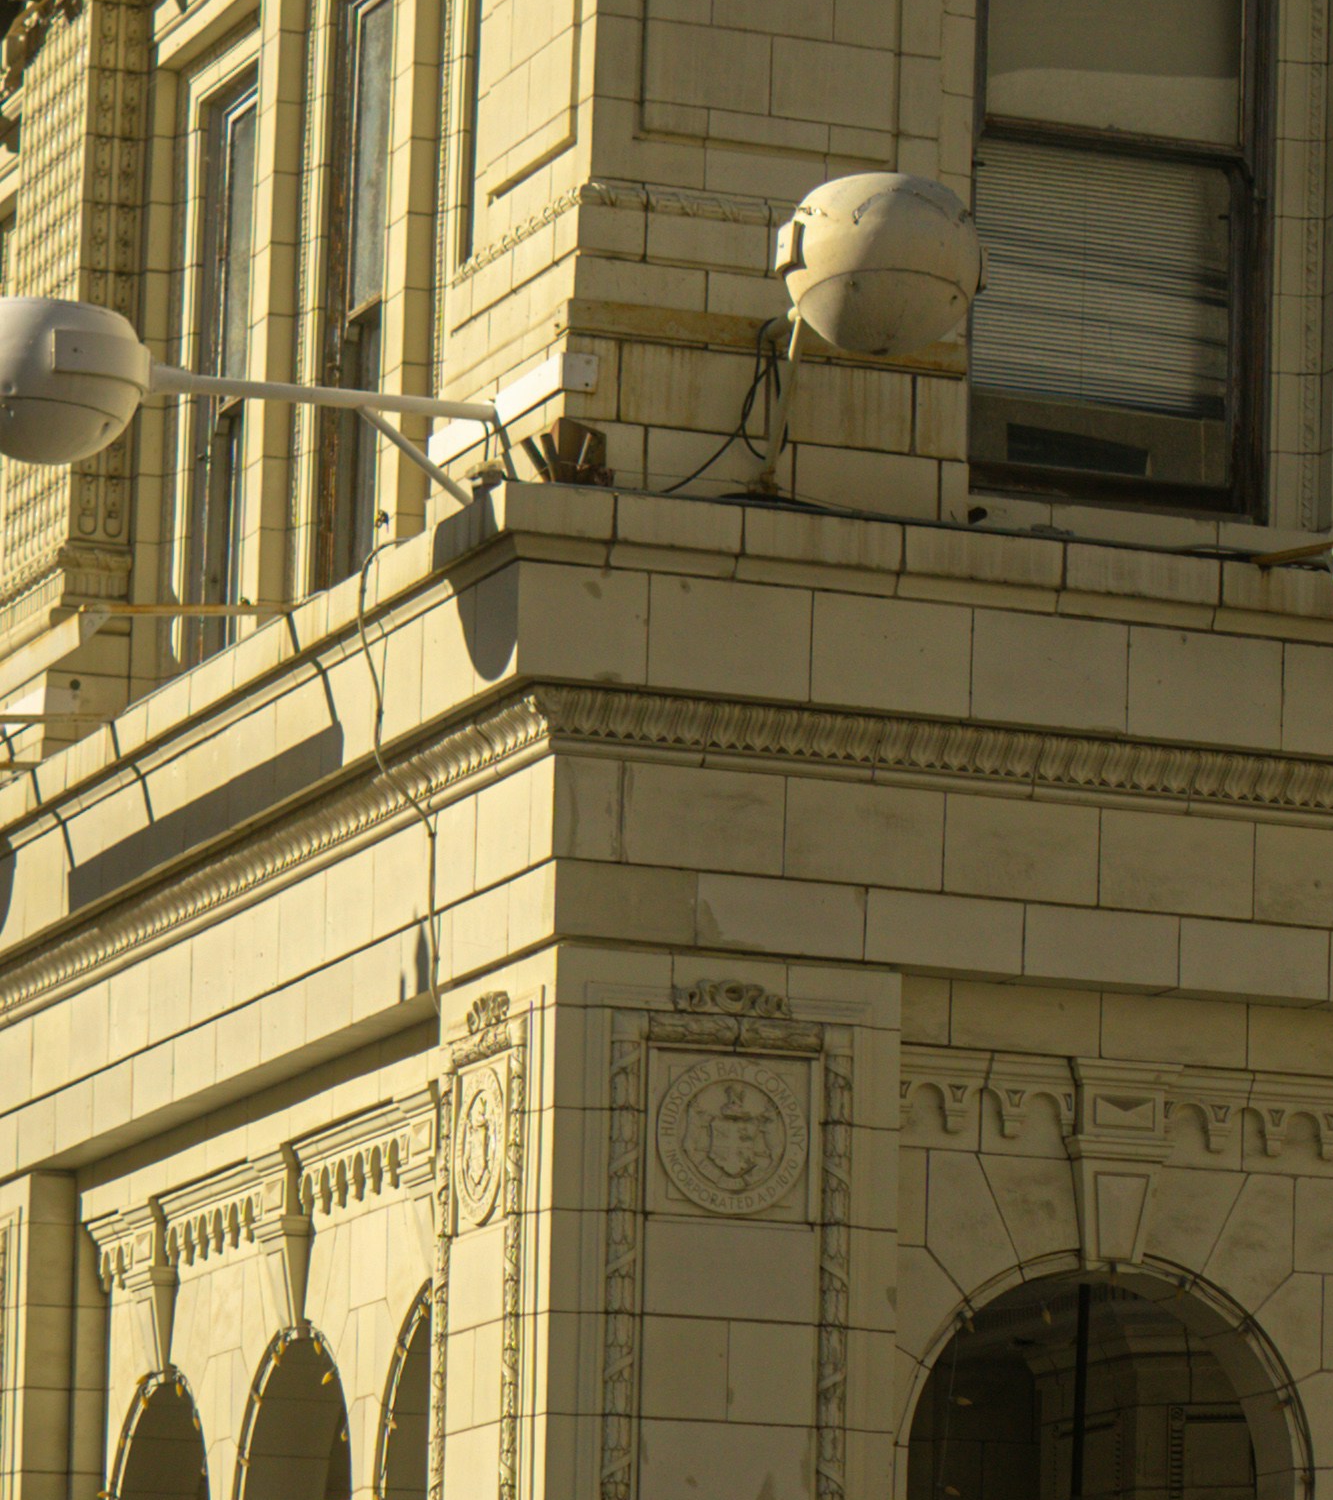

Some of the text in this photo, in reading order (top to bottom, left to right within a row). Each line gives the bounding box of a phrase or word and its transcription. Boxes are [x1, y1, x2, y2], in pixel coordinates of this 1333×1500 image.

[716, 1061, 747, 1079] BAY
[754, 1069, 806, 1152] COMPANY
[664, 1148, 755, 1211] INCORPORATED
